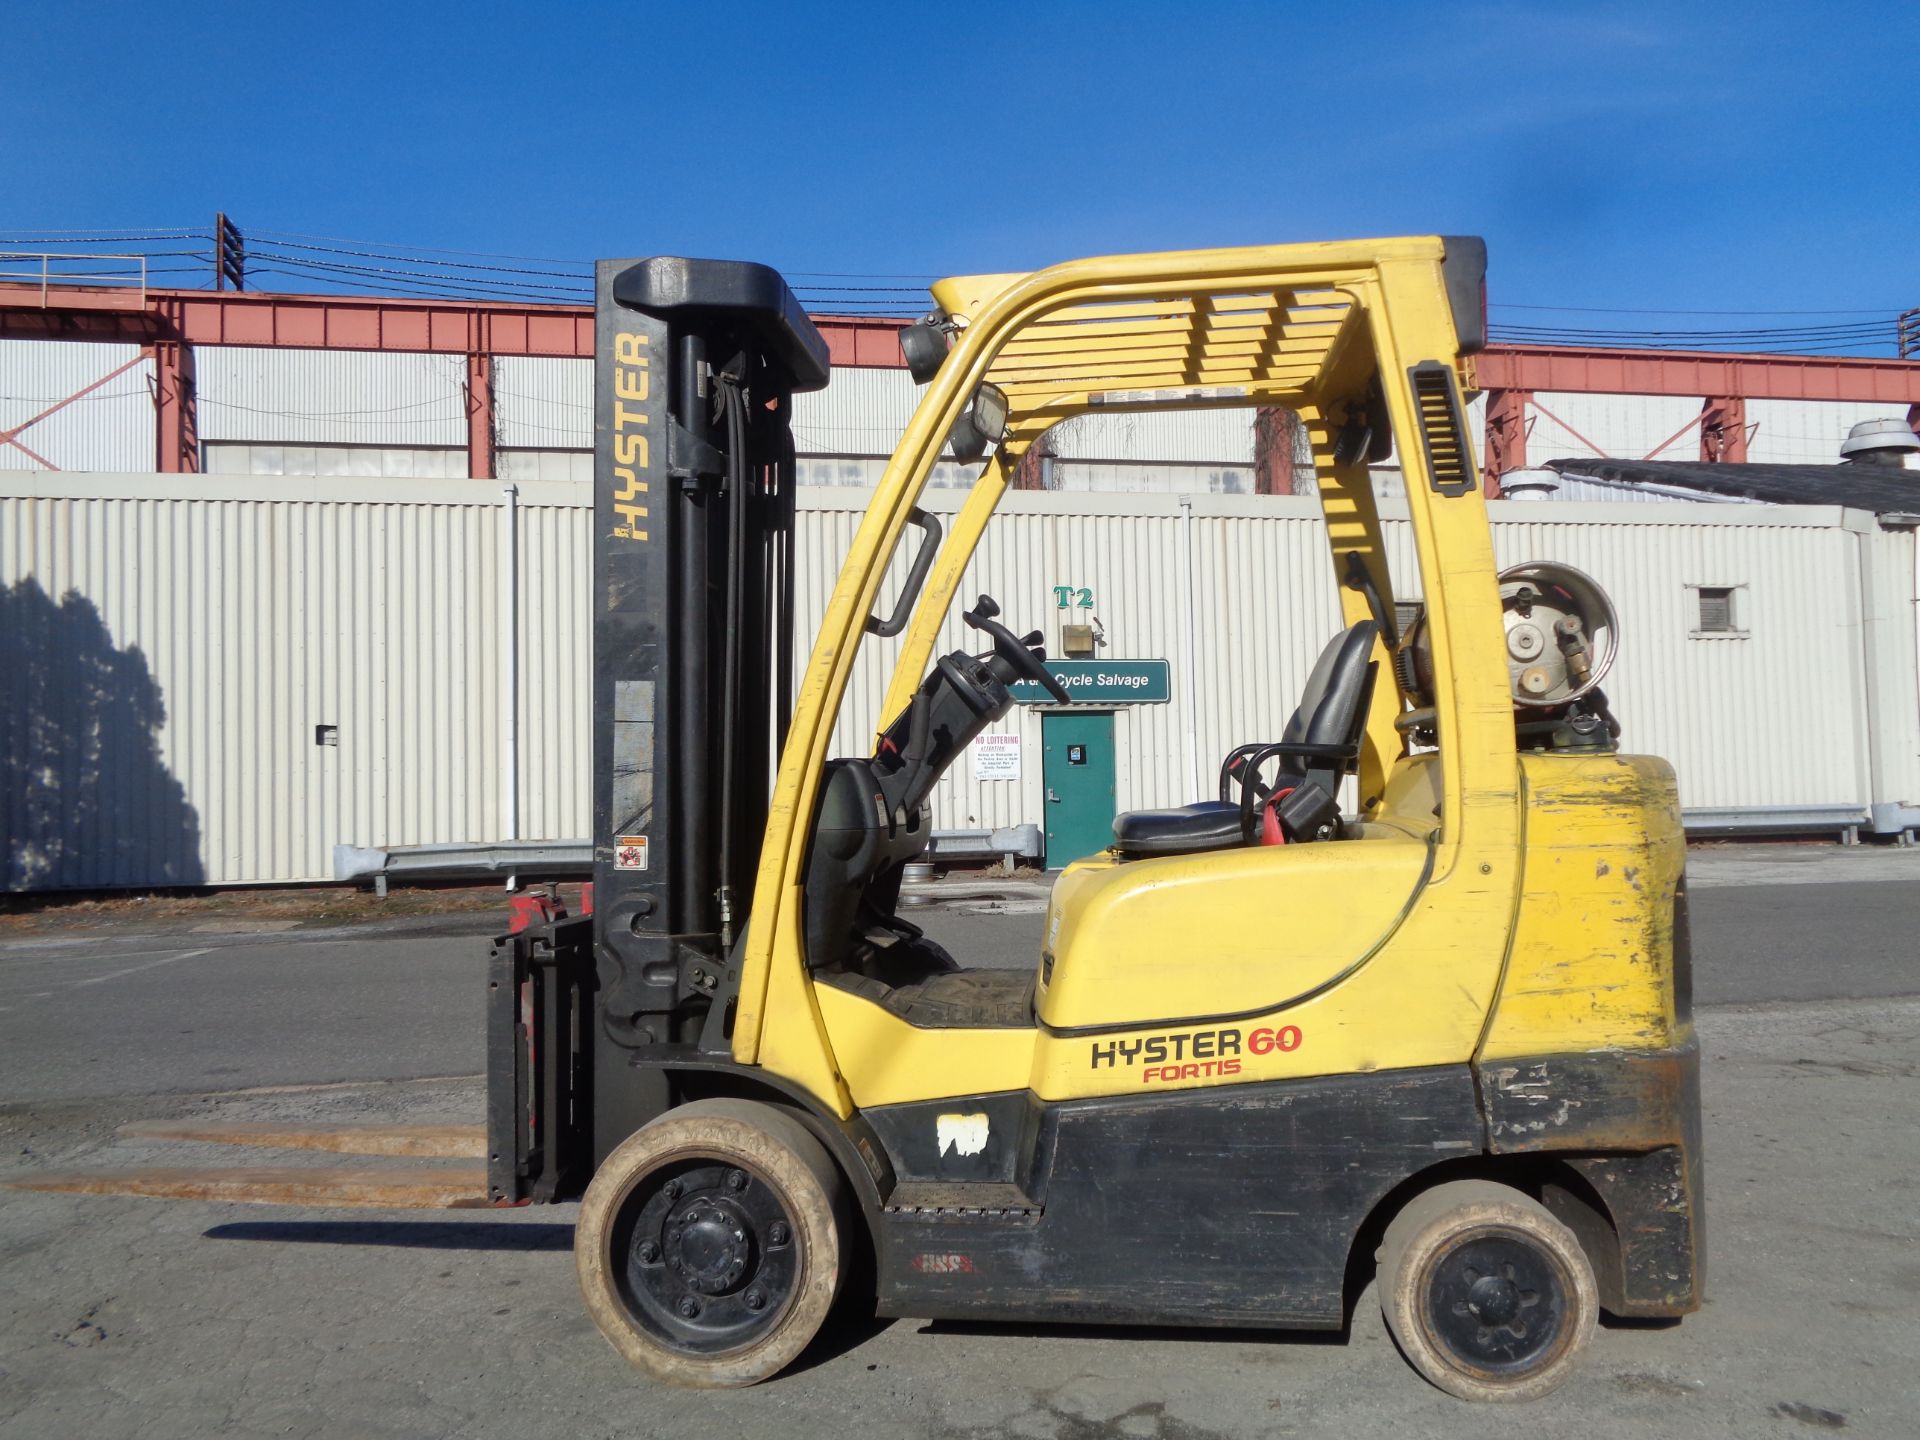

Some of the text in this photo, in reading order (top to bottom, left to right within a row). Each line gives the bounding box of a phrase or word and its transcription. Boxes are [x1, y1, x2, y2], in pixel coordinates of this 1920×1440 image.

[614, 332, 649, 541] HYSTER
[1053, 586, 1094, 609] T2
[1055, 673, 1093, 688] Cycle
[1096, 673, 1149, 688] Salvage
[975, 736, 1019, 746] NO LOITERING
[1092, 1025, 1303, 1069] HYSTER 60
[1143, 1058, 1242, 1083] FORTIS
